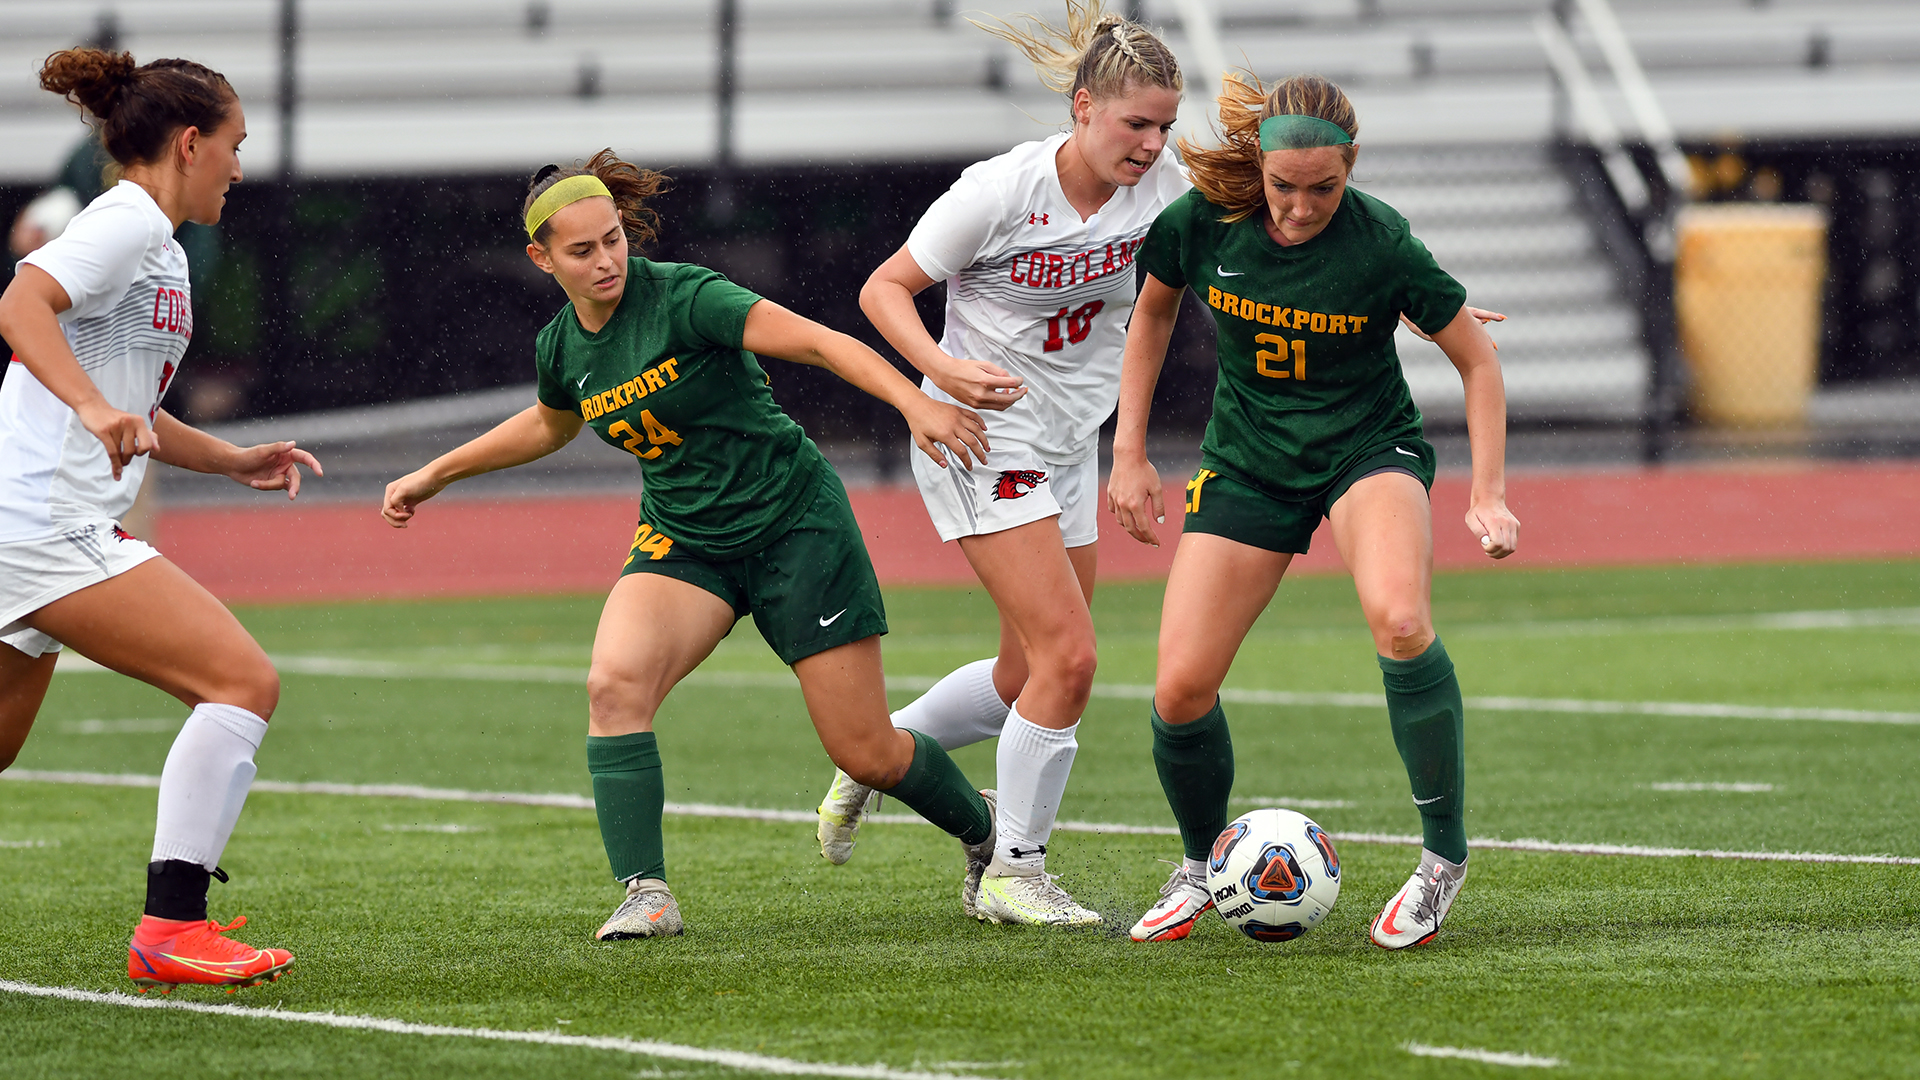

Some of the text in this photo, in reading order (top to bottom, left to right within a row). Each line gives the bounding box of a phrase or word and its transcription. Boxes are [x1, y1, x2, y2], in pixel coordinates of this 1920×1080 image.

[1043, 299, 1105, 354] 10
[1208, 285, 1368, 334] BROCKPORT
[1254, 332, 1306, 381] 21
[580, 357, 680, 422] ROCKPORT
[608, 408, 684, 460] 24
[1213, 883, 1238, 902] NCAA
[1222, 902, 1255, 919] Wilson
